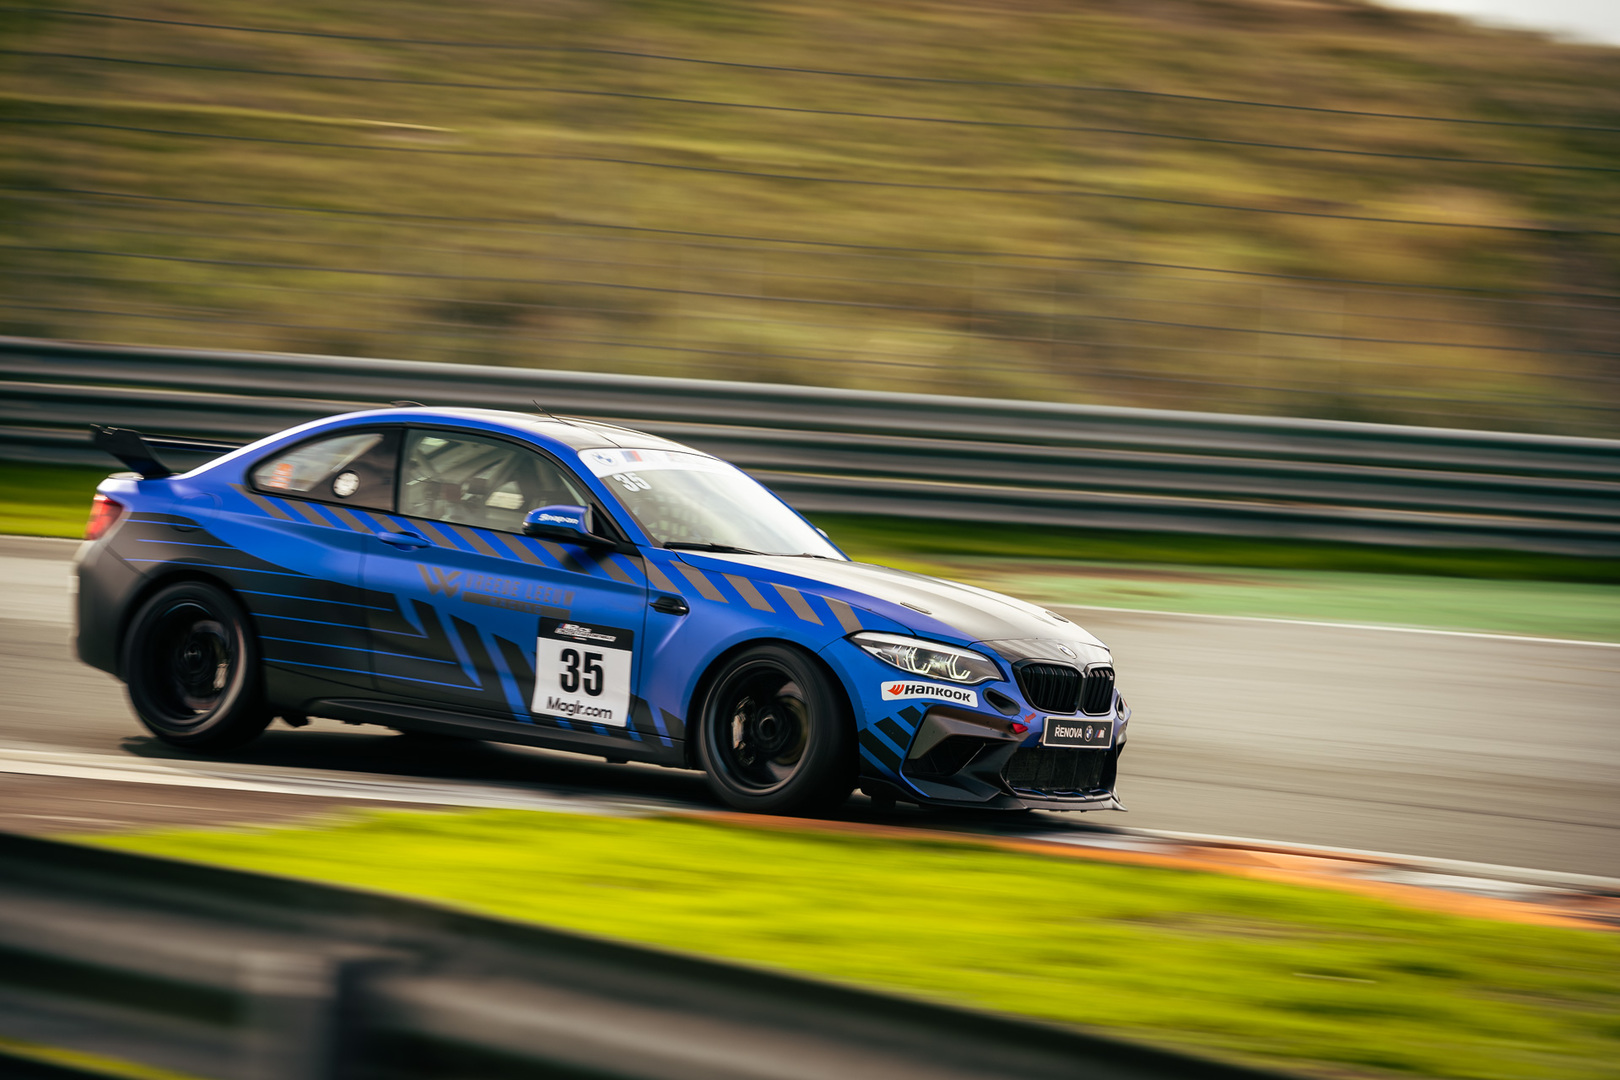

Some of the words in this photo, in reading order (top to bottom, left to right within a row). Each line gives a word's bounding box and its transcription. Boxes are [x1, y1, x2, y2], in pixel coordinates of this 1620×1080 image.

[612, 472, 652, 492] 35
[559, 648, 604, 697] 35
[1054, 726, 1083, 738] RENOVA
